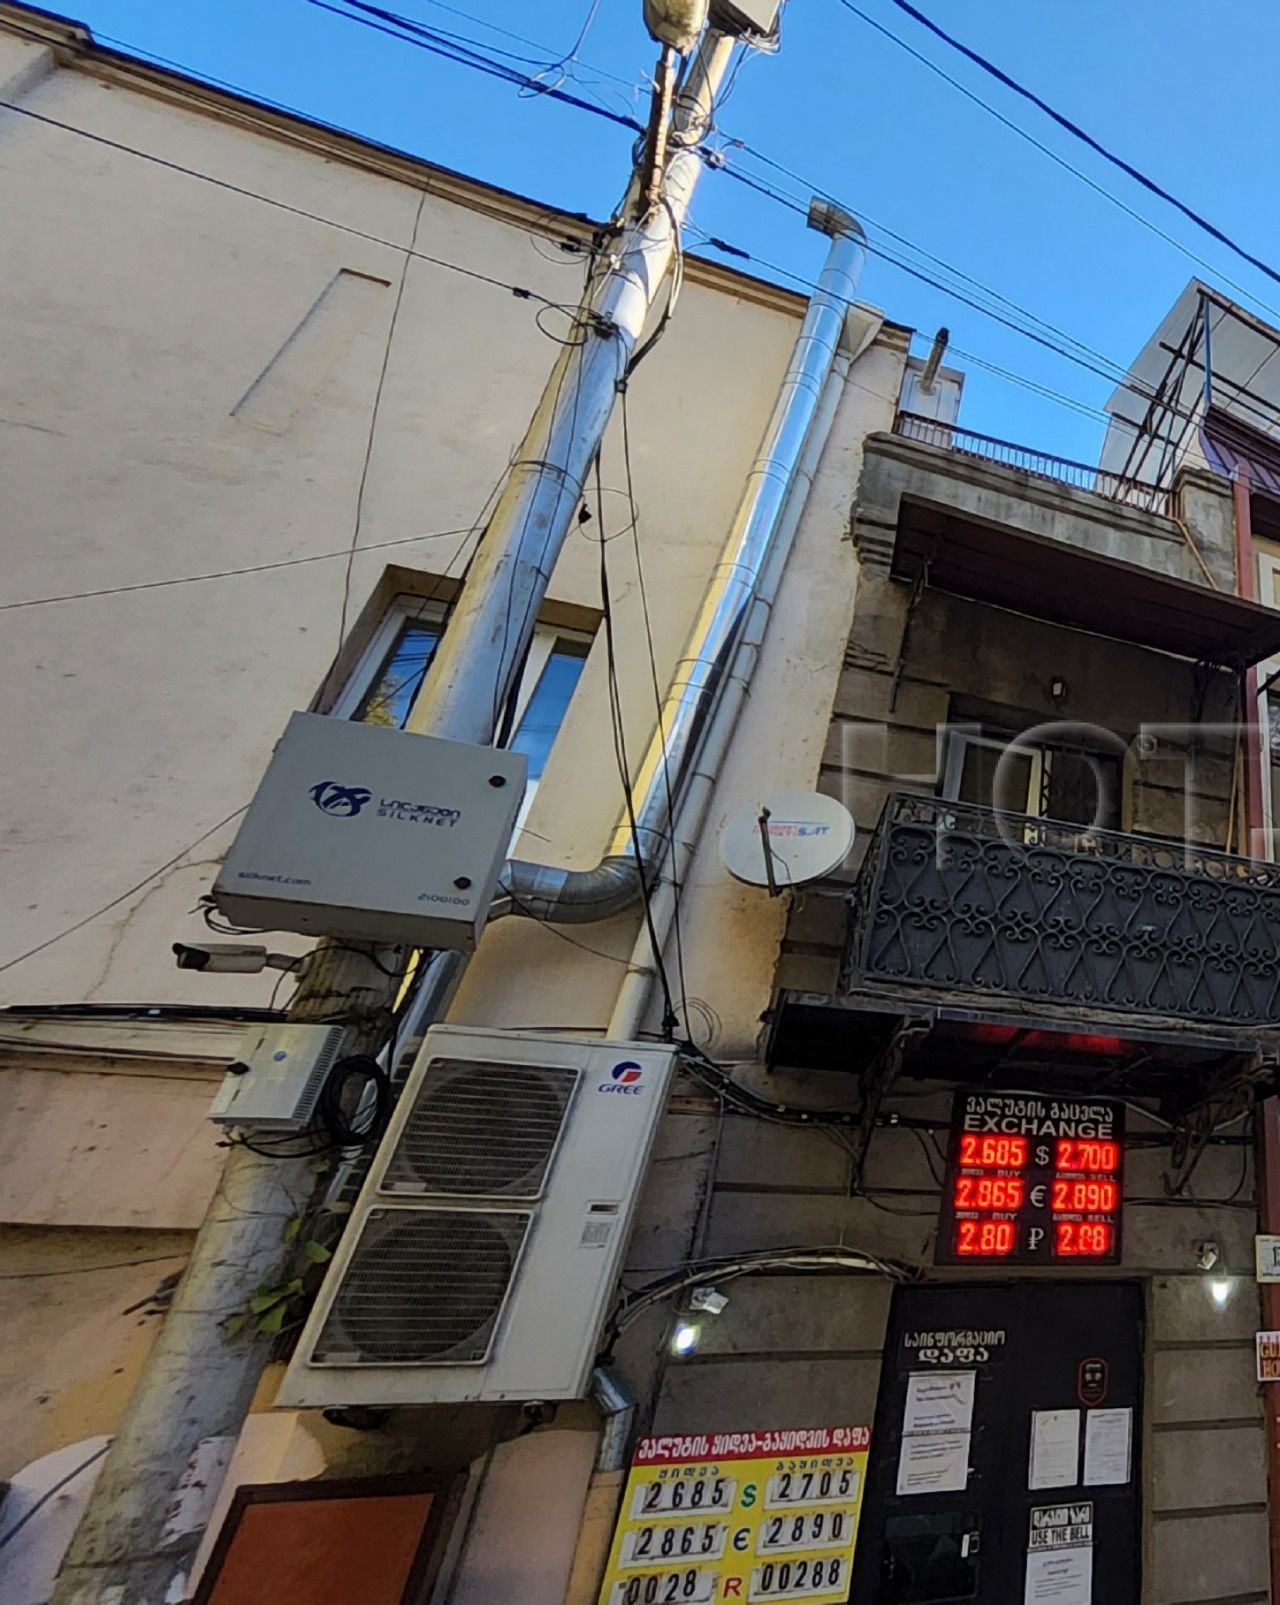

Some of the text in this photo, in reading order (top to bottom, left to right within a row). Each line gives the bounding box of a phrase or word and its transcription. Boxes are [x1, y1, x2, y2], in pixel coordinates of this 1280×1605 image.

[377, 808, 458, 827] SILKNET
[598, 1083, 645, 1095] GREE
[964, 1114, 1113, 1139] EXCHANGE
[1035, 1145, 1050, 1165] $
[997, 1169, 1021, 1178] BUY
[955, 1179, 1114, 1210] 2.865 € 2.890
[992, 1212, 1018, 1221] BUY
[959, 1222, 1012, 1251] 2.80
[918, 1347, 989, 1363] დაფა
[832, 1427, 870, 1447] დაფა
[658, 1465, 720, 1478] ყიდვა
[646, 1478, 727, 1508] 2685
[778, 1470, 851, 1499] 2705
[637, 1524, 717, 1555] 2865
[767, 1513, 843, 1544] 2890
[1032, 1526, 1089, 1545] USE THE BELL
[723, 1577, 743, 1599] R
[761, 1559, 840, 1590] 00288
